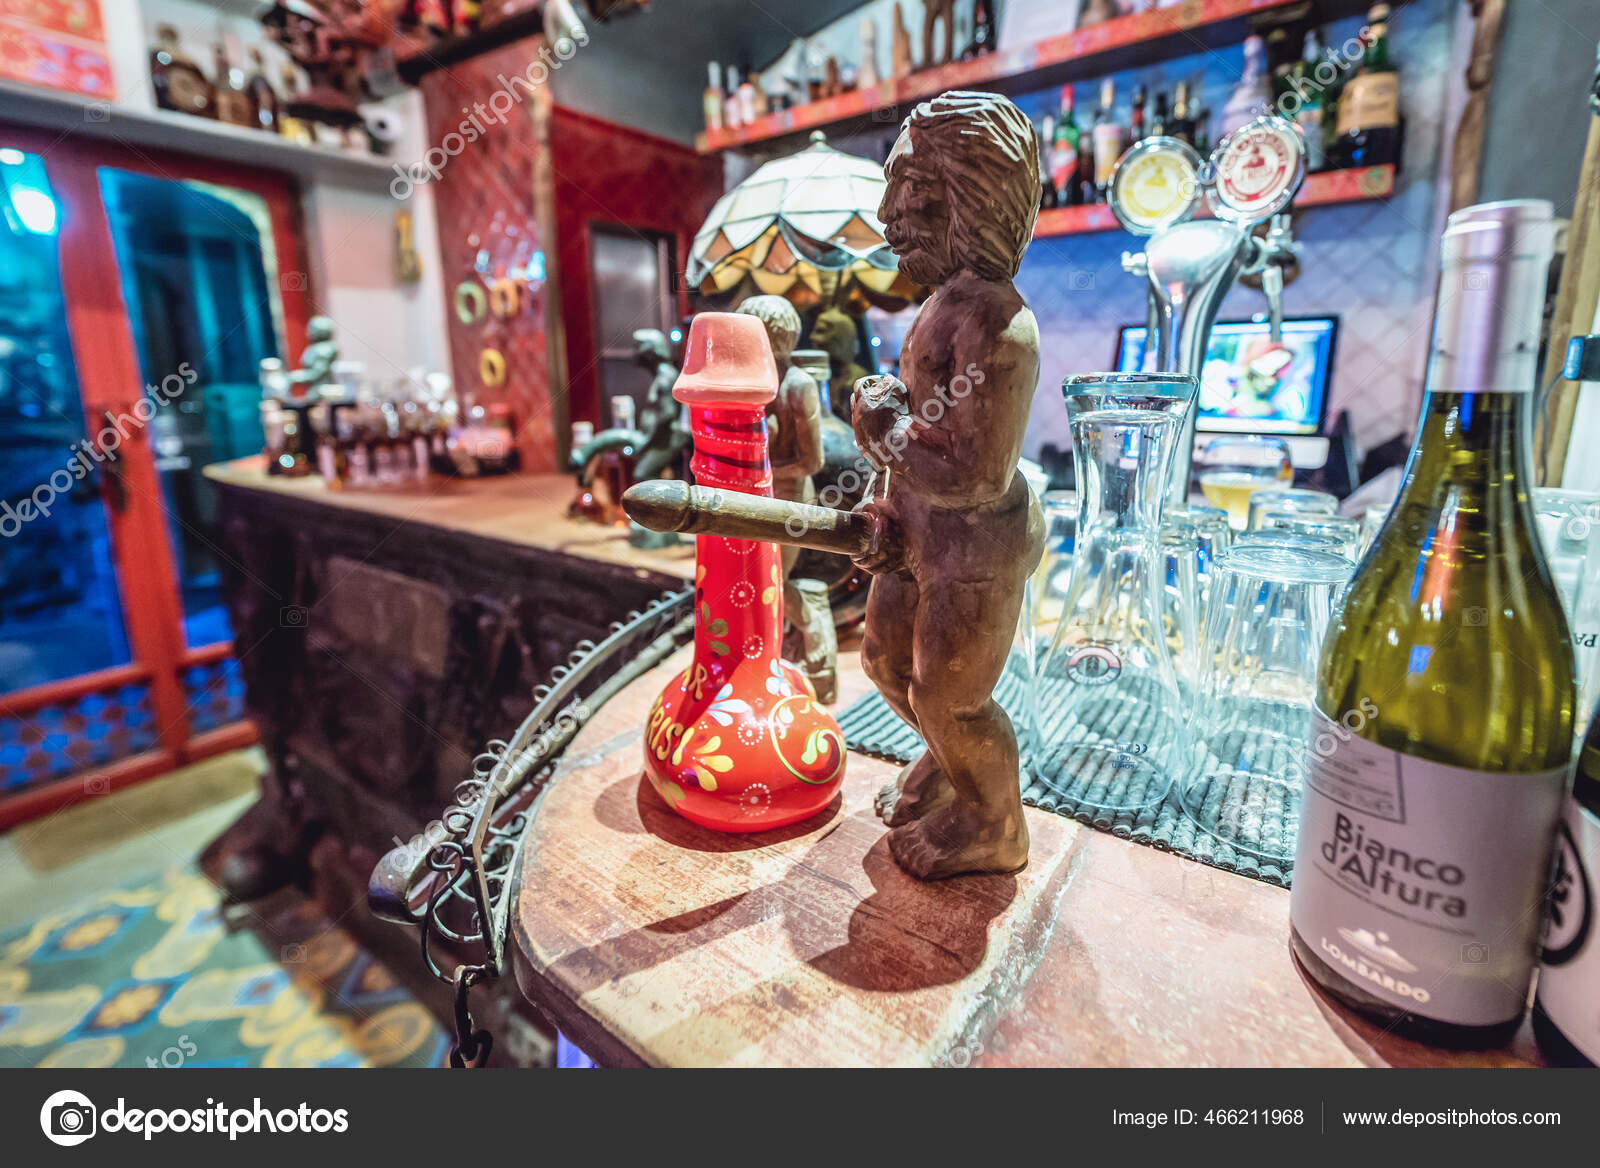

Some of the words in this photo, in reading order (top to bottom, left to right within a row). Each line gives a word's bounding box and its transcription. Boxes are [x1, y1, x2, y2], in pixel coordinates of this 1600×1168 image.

[1321, 836, 1467, 918] d'Altura
[1335, 812, 1466, 886] Bianco
[1320, 936, 1431, 1003] LOMBARDO
